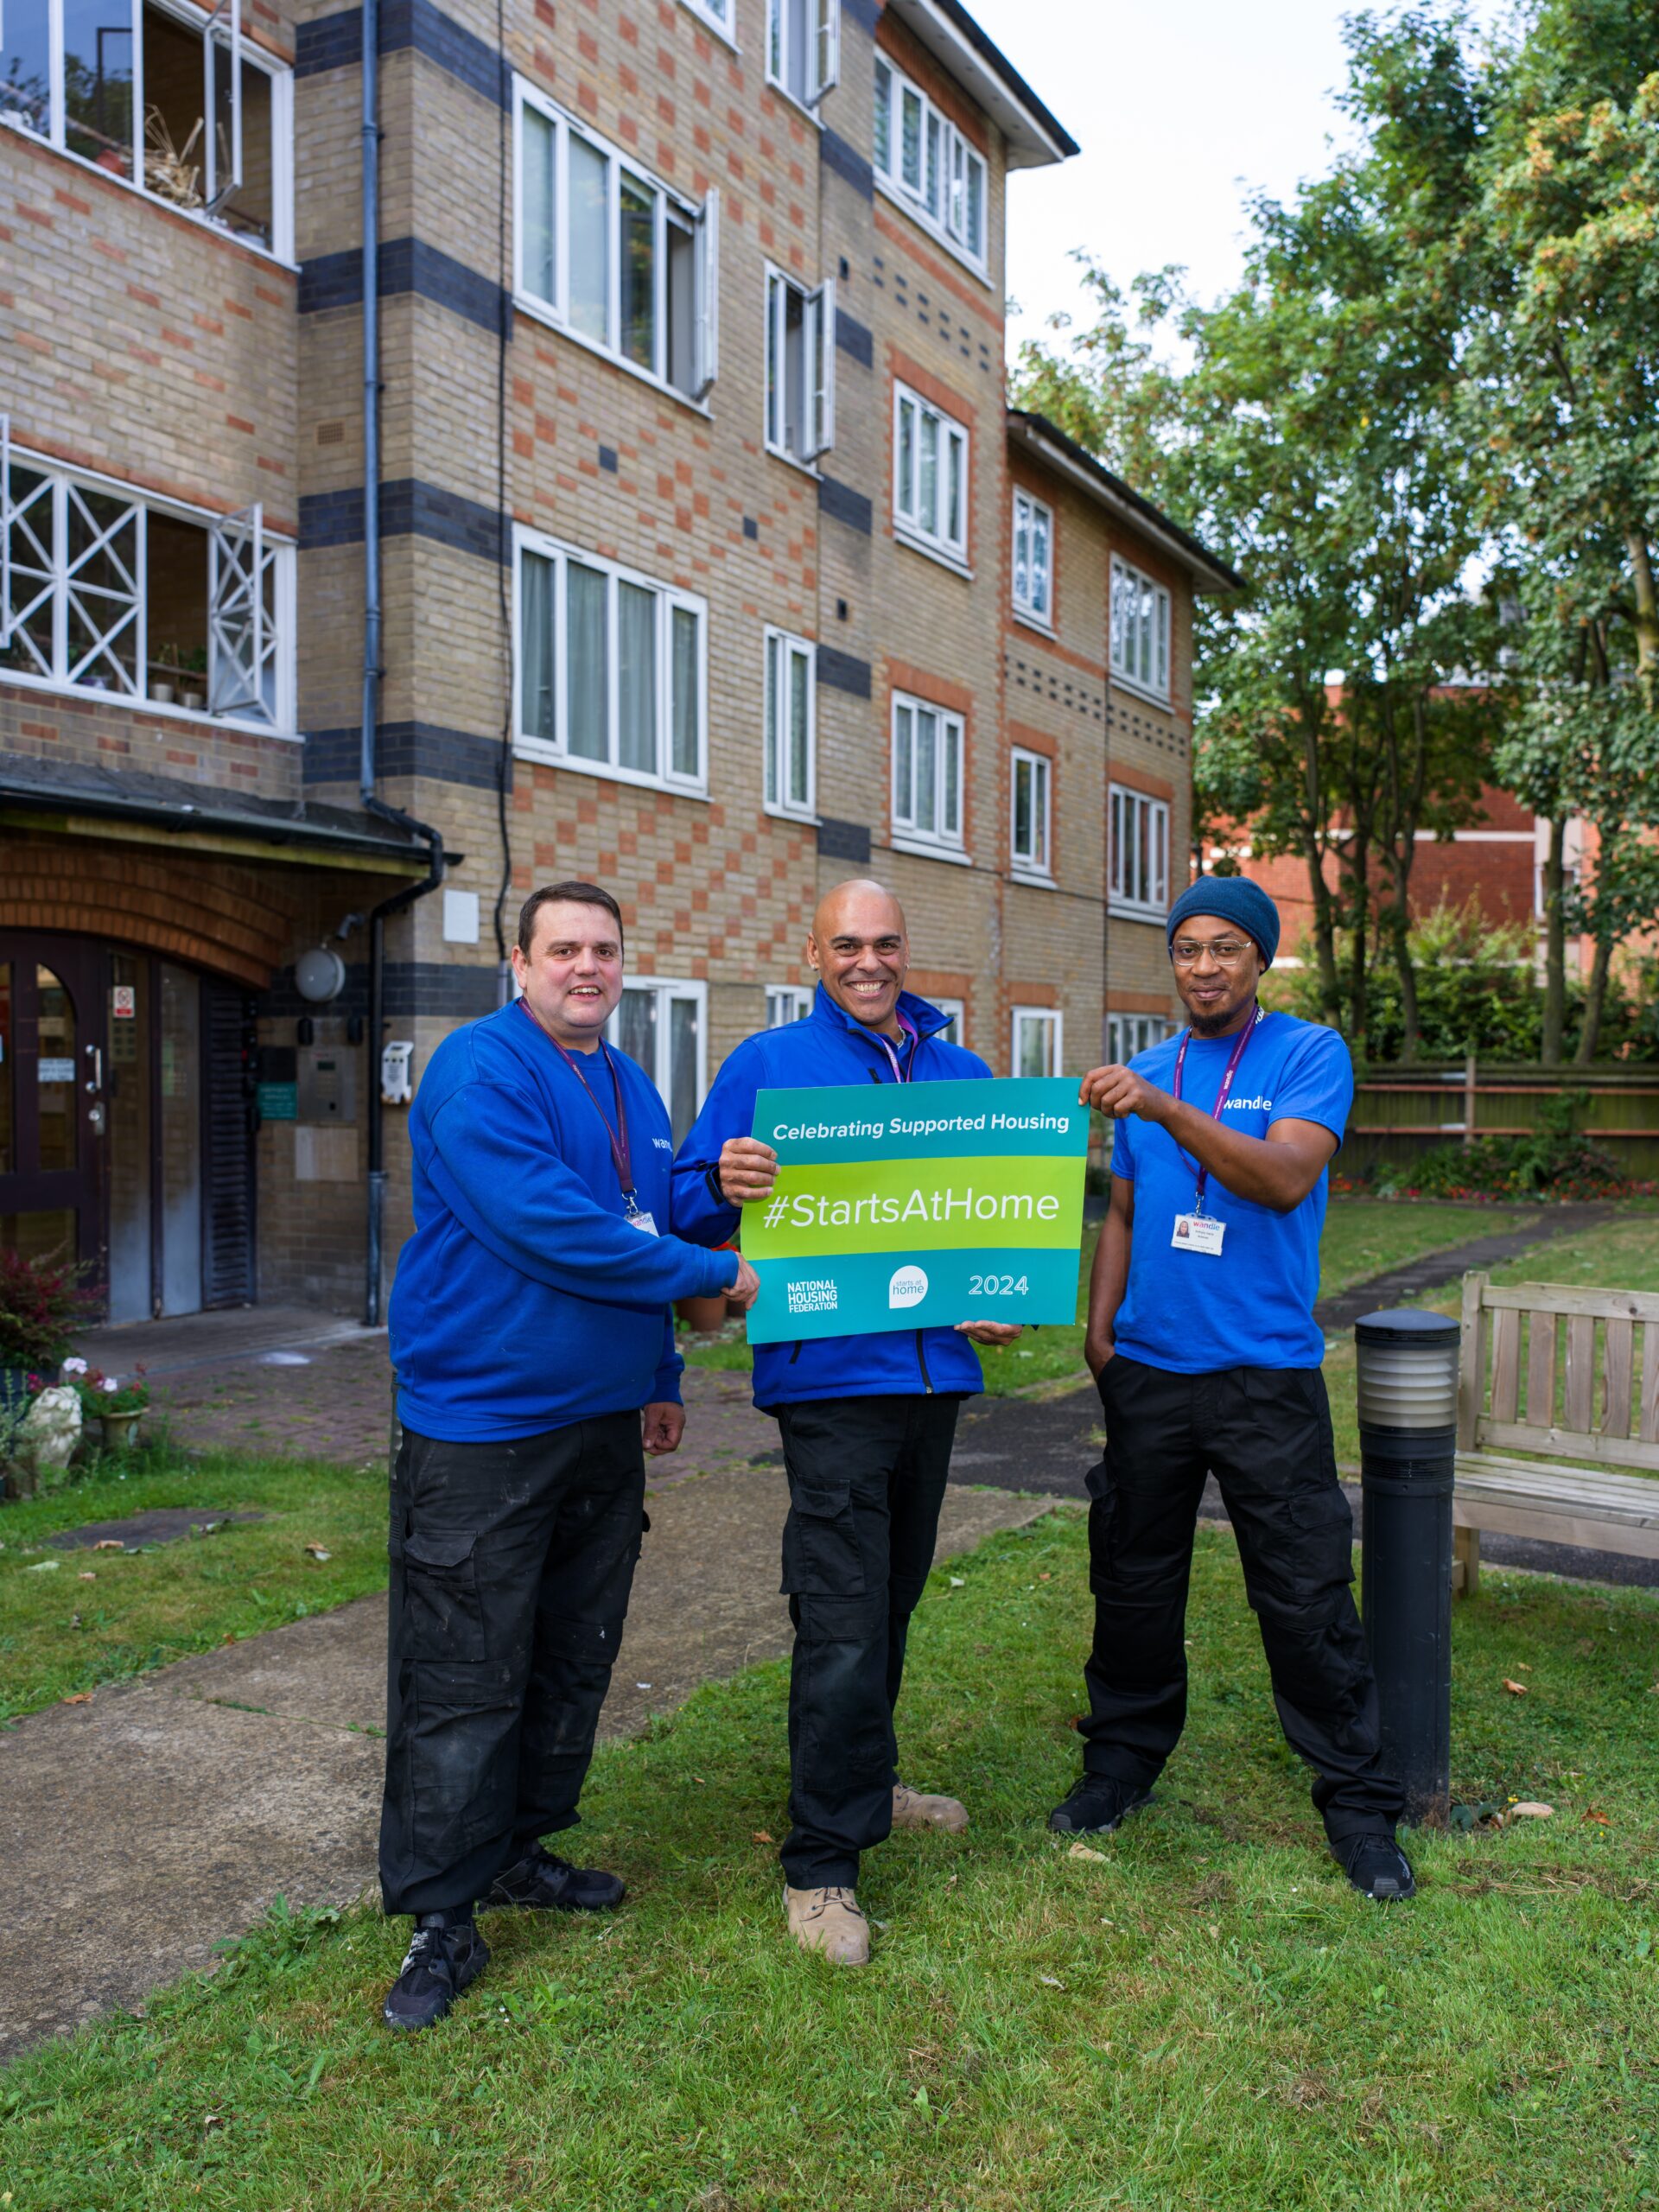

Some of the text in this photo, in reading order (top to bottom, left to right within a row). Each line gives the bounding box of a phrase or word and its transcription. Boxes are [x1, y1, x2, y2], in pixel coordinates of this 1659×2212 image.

[1224, 1096, 1273, 1111] wandle
[772, 1113, 1070, 1141] Celebrating Supported Housing
[763, 1187, 1059, 1230] #StartsAtHome
[1193, 1221, 1221, 1231] wandle
[787, 1279, 837, 1293] NATIONAL
[893, 1285, 925, 1295] home
[968, 1274, 1030, 1296] 2024
[788, 1289, 837, 1305] HOUSING
[789, 1300, 838, 1313] FEDERATION
